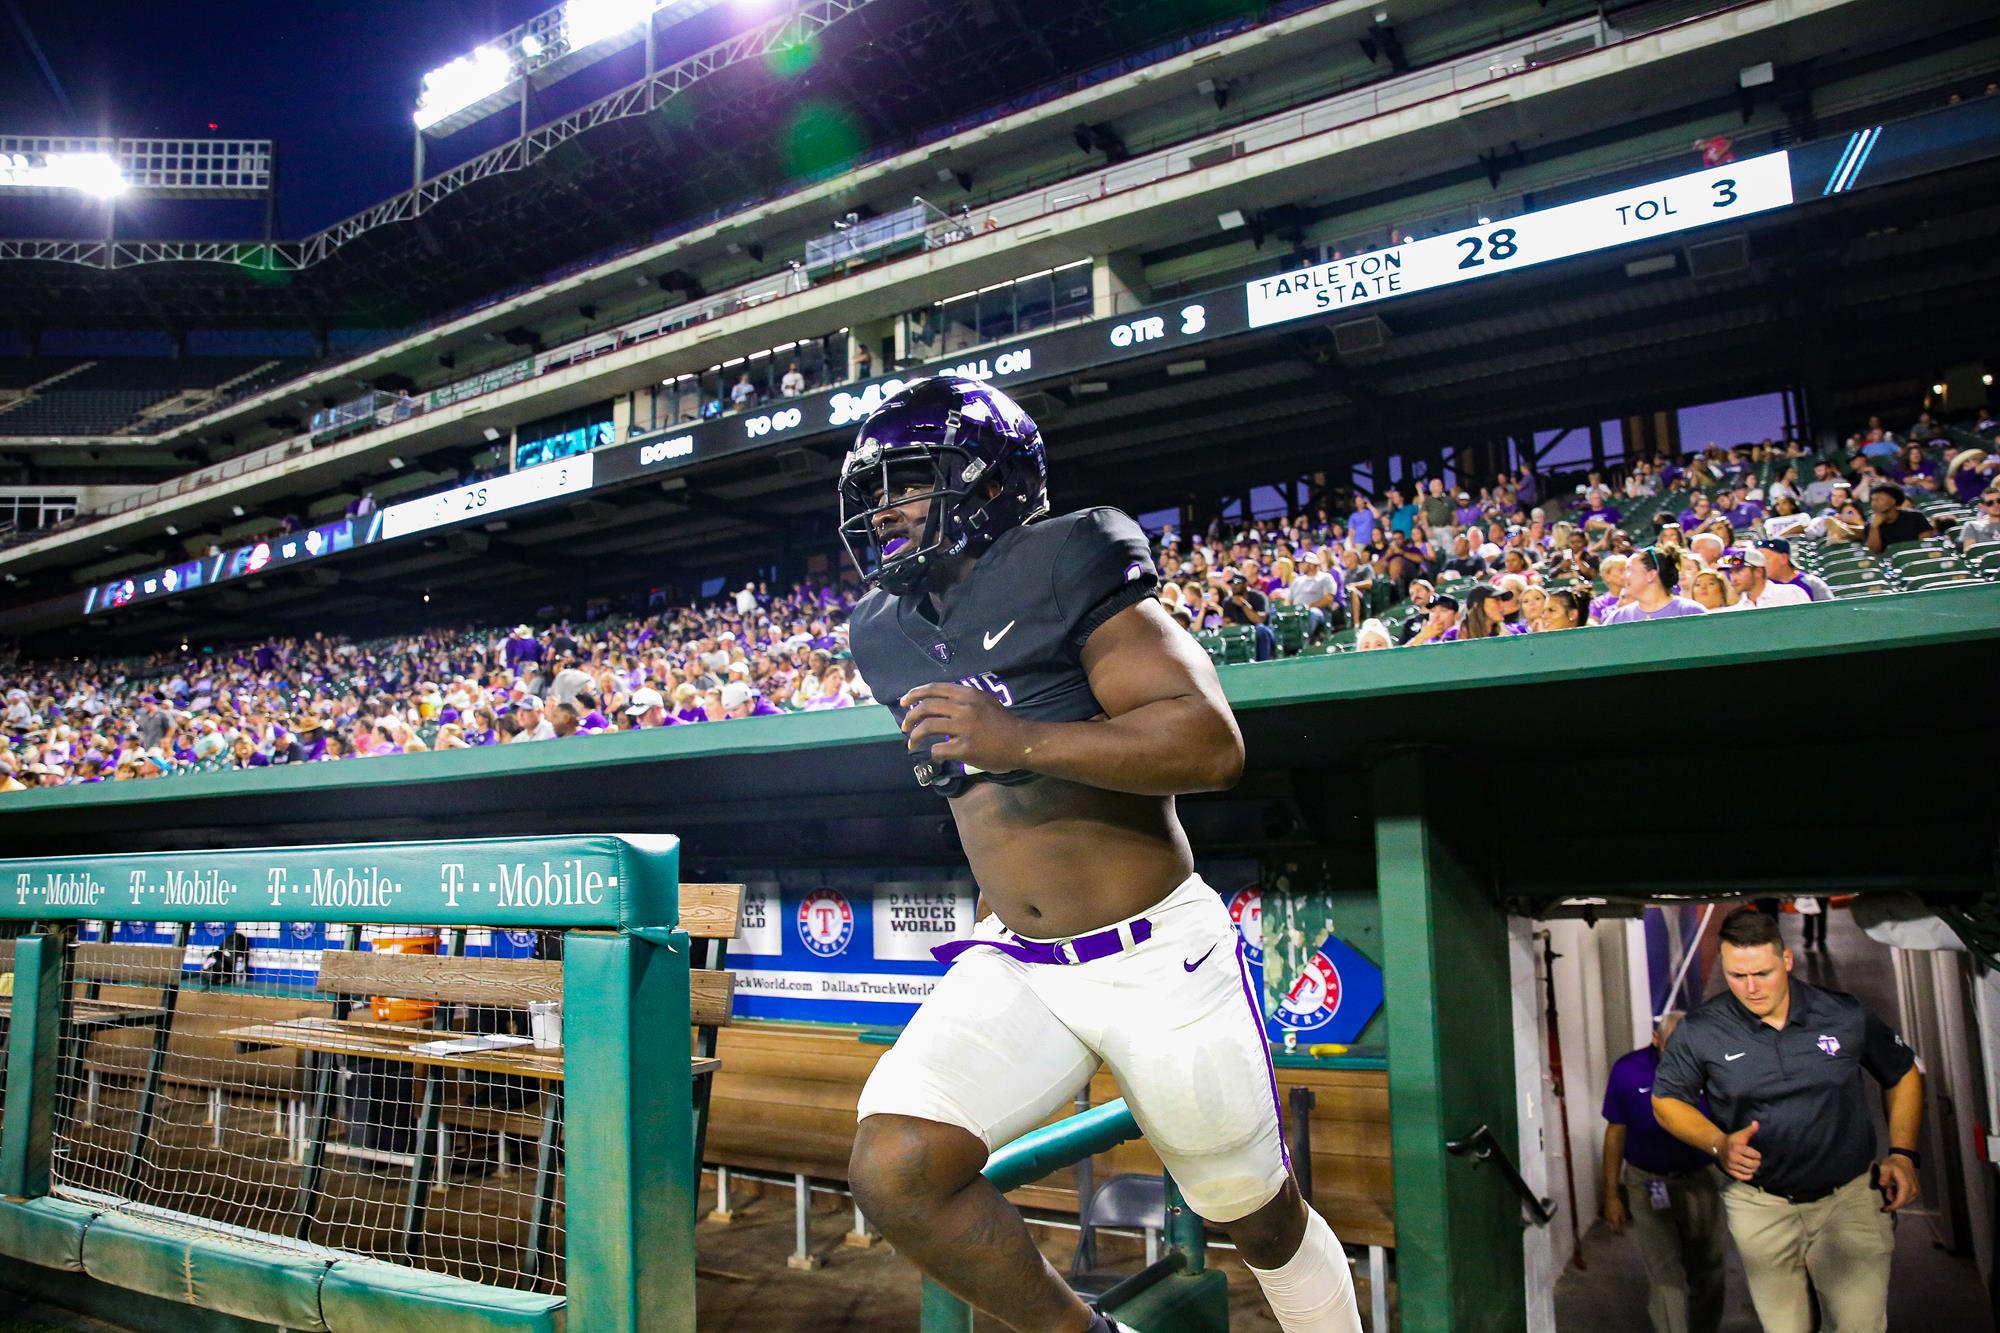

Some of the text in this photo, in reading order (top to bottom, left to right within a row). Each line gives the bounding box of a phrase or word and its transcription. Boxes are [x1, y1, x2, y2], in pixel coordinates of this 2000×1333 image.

[1616, 179, 1738, 226] TOL 3
[1456, 228, 1518, 270] 28
[1260, 250, 1401, 299] TARLETON
[1316, 272, 1401, 308] STATE
[1110, 304, 1206, 347] QTR 3
[995, 348, 1031, 375] ON
[745, 414, 771, 438] TO
[640, 435, 693, 465] DOWN
[890, 893, 957, 905] DALLAS
[891, 906, 955, 919] TRUCK
[815, 908, 835, 936] T
[891, 920, 956, 932] WORLD
